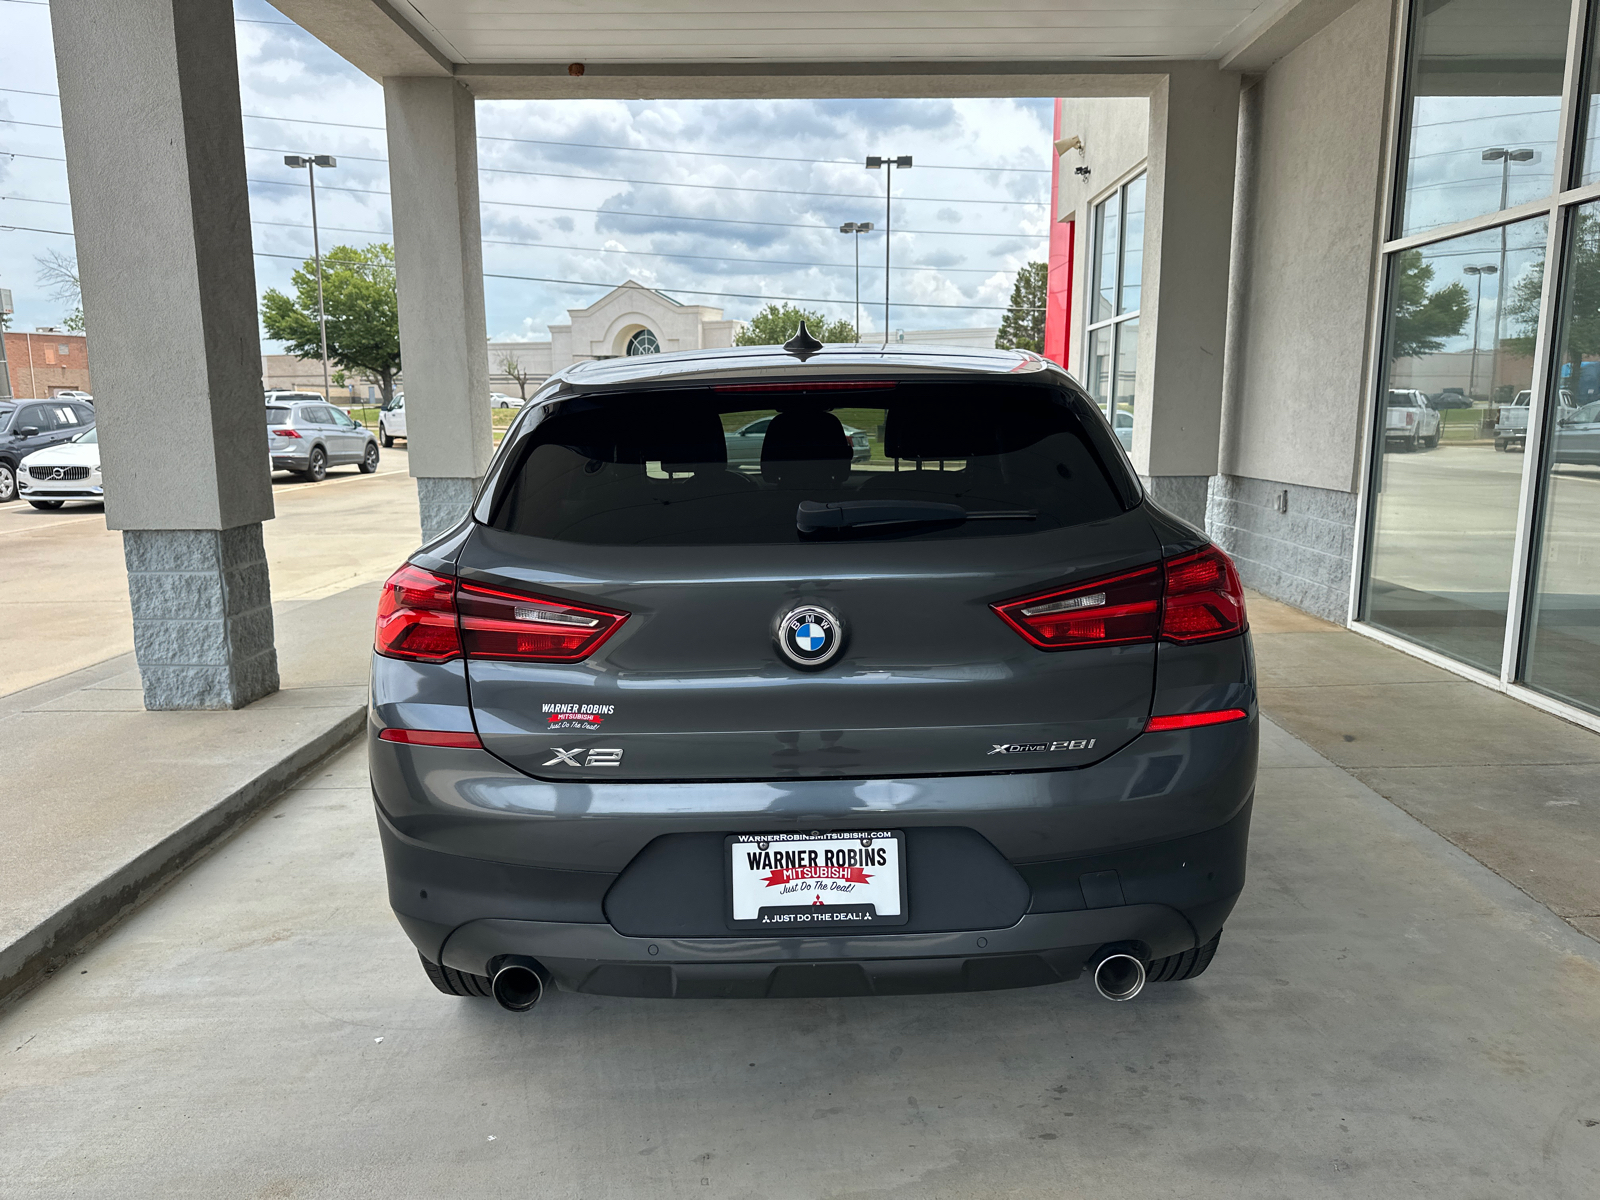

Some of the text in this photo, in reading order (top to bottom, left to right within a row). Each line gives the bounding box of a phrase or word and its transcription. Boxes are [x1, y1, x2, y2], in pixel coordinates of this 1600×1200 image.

[790, 614, 830, 630] BMW
[542, 704, 614, 714] WARNER ROBINS
[582, 722, 600, 730] Deal!
[542, 748, 624, 766] X2
[747, 848, 886, 870] WARNER ROBINS
[783, 868, 851, 880] MITSUBISHI
[780, 880, 856, 894] Just Do The Deal!
[833, 912, 862, 920] DEAL!
